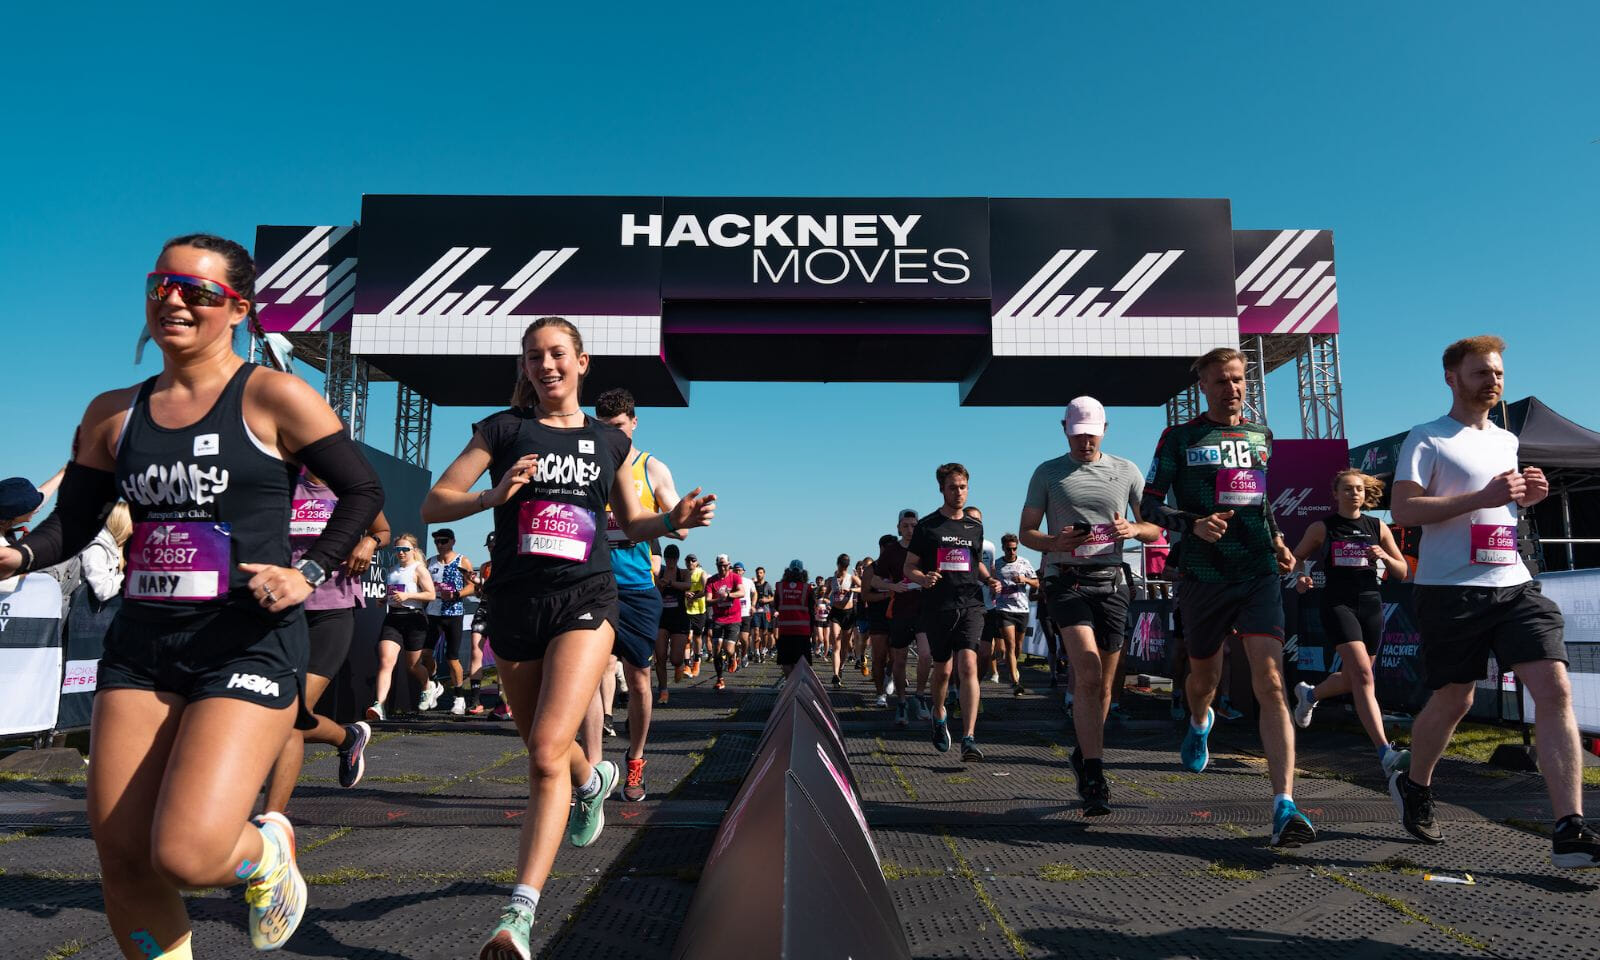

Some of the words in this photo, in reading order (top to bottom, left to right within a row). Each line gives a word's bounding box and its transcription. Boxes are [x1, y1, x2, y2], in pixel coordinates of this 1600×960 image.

[621, 213, 922, 247] HACKNEY
[753, 248, 971, 284] MOVES
[1189, 449, 1219, 462] DKB
[1221, 440, 1252, 468] 36
[533, 453, 600, 486] ACKNEY
[121, 461, 229, 505] HACKNEY
[1230, 480, 1237, 489] C
[1238, 481, 1257, 490] 3148
[297, 510, 305, 519] C
[531, 518, 540, 529] B
[543, 520, 579, 535] 13612
[1488, 537, 1495, 546] B
[142, 547, 151, 563] C
[154, 547, 198, 564] 2687
[138, 574, 181, 595] MARY
[1382, 644, 1419, 656] HACKNEY
[226, 673, 280, 697] HOKA
